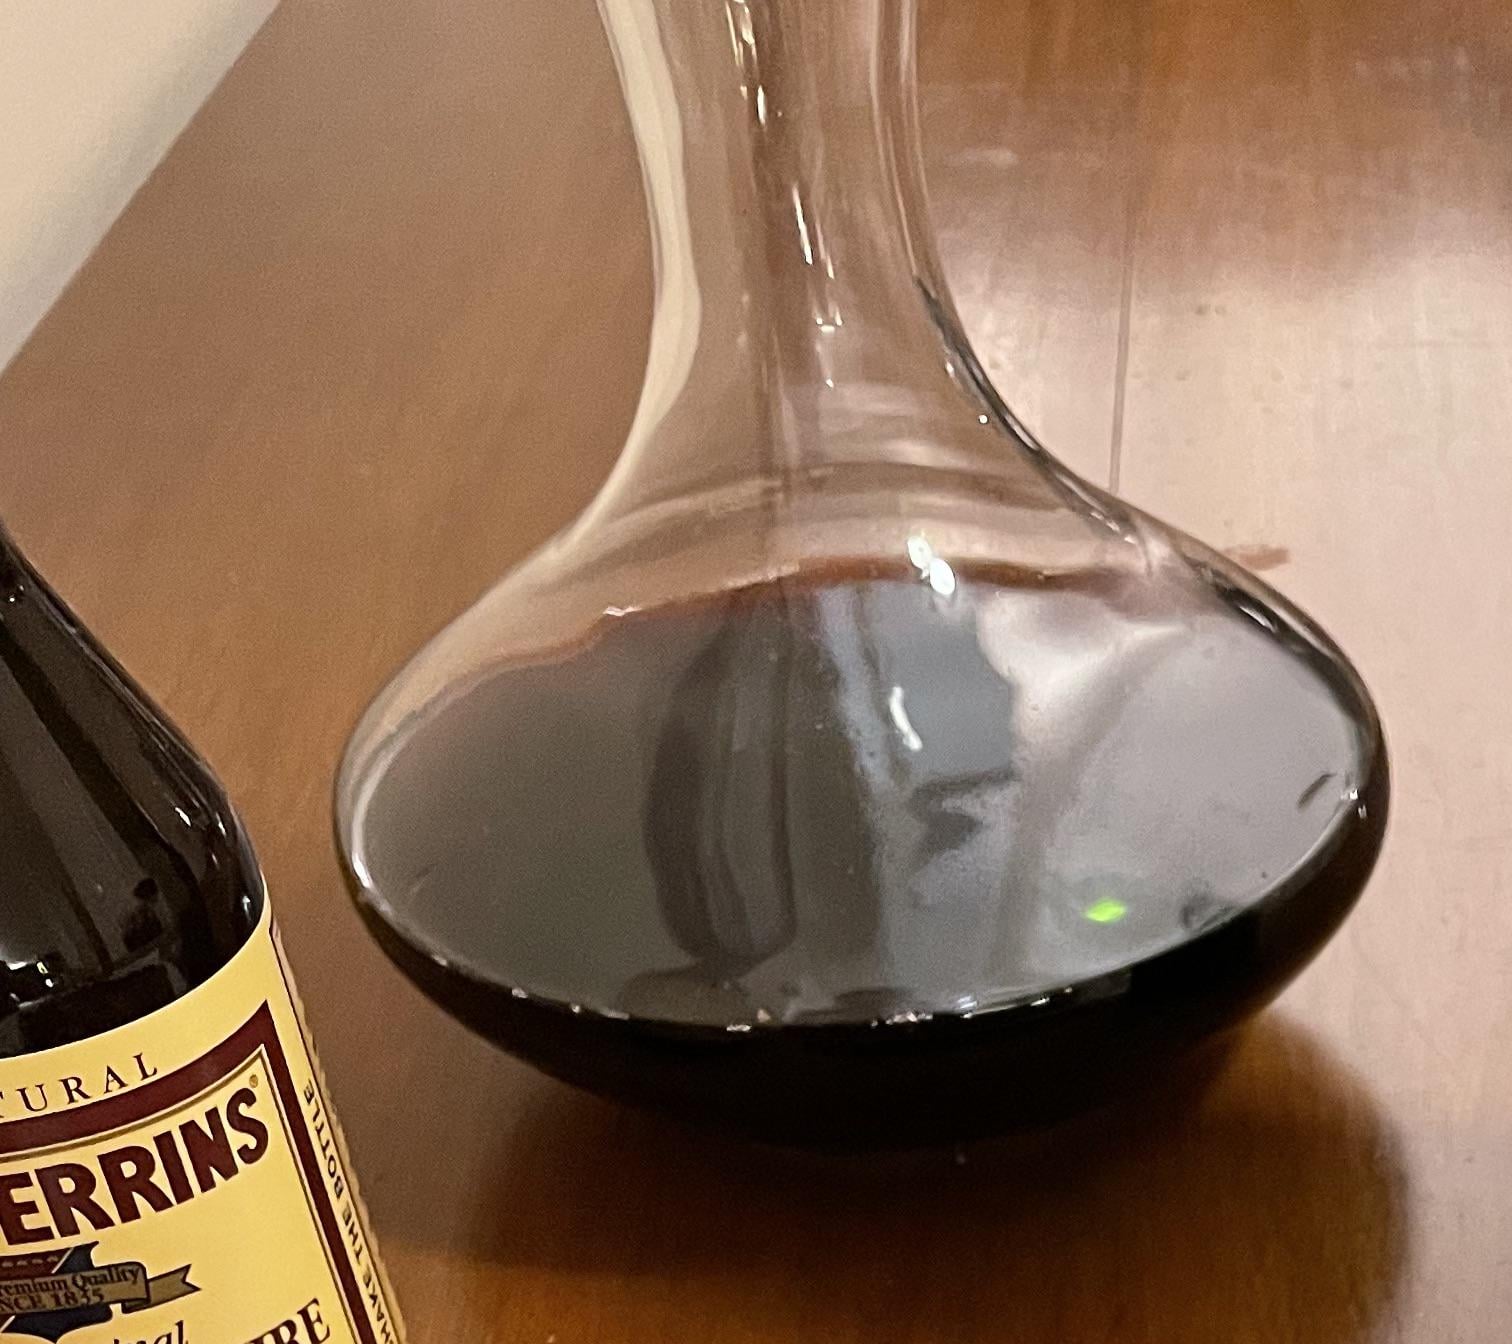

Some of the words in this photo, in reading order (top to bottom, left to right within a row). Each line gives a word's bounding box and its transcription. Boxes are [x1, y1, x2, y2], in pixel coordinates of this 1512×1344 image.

[304, 1078, 344, 1200] BOTTLE
[342, 1202, 363, 1265] THE
[72, 1266, 140, 1290] Quality
